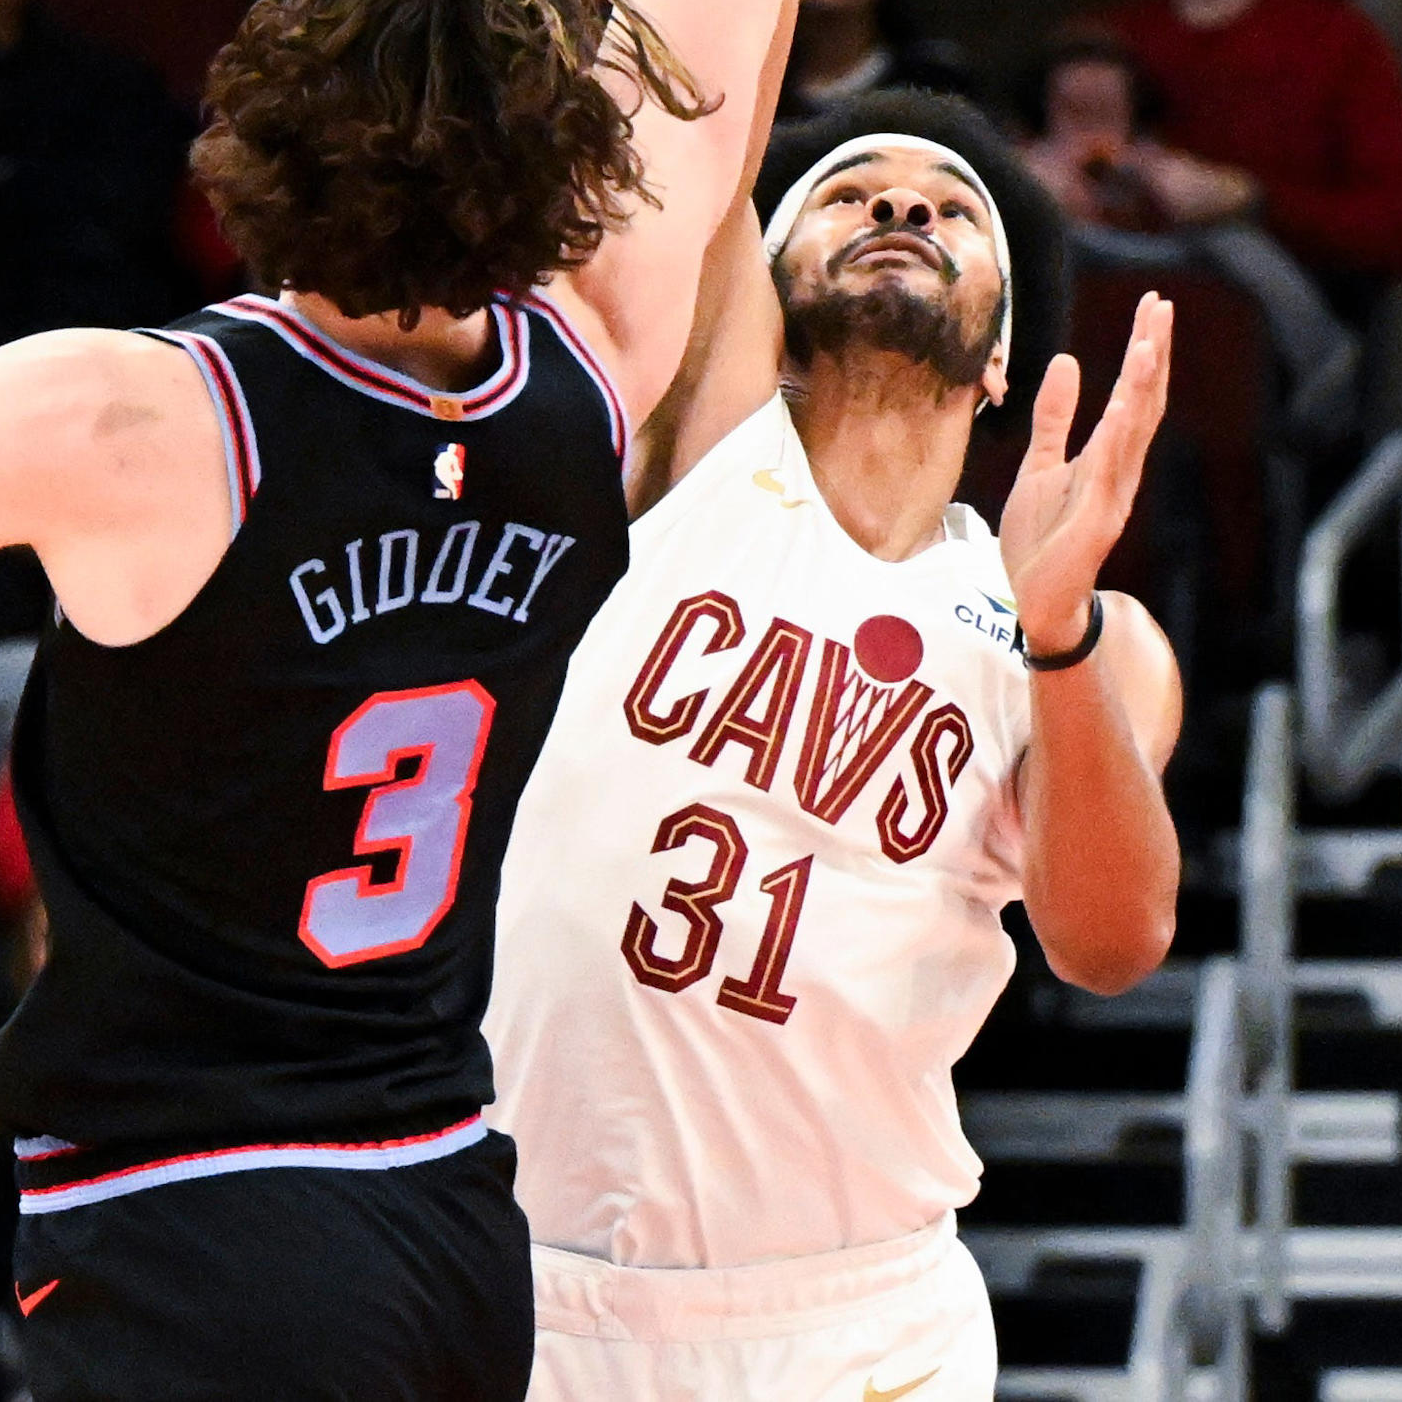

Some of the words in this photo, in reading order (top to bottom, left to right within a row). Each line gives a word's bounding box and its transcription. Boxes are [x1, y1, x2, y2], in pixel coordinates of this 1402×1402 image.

[289, 519, 575, 645] GIDDEY
[298, 678, 497, 969] 3
[623, 589, 975, 865] CAVS
[620, 802, 815, 1026] 31
